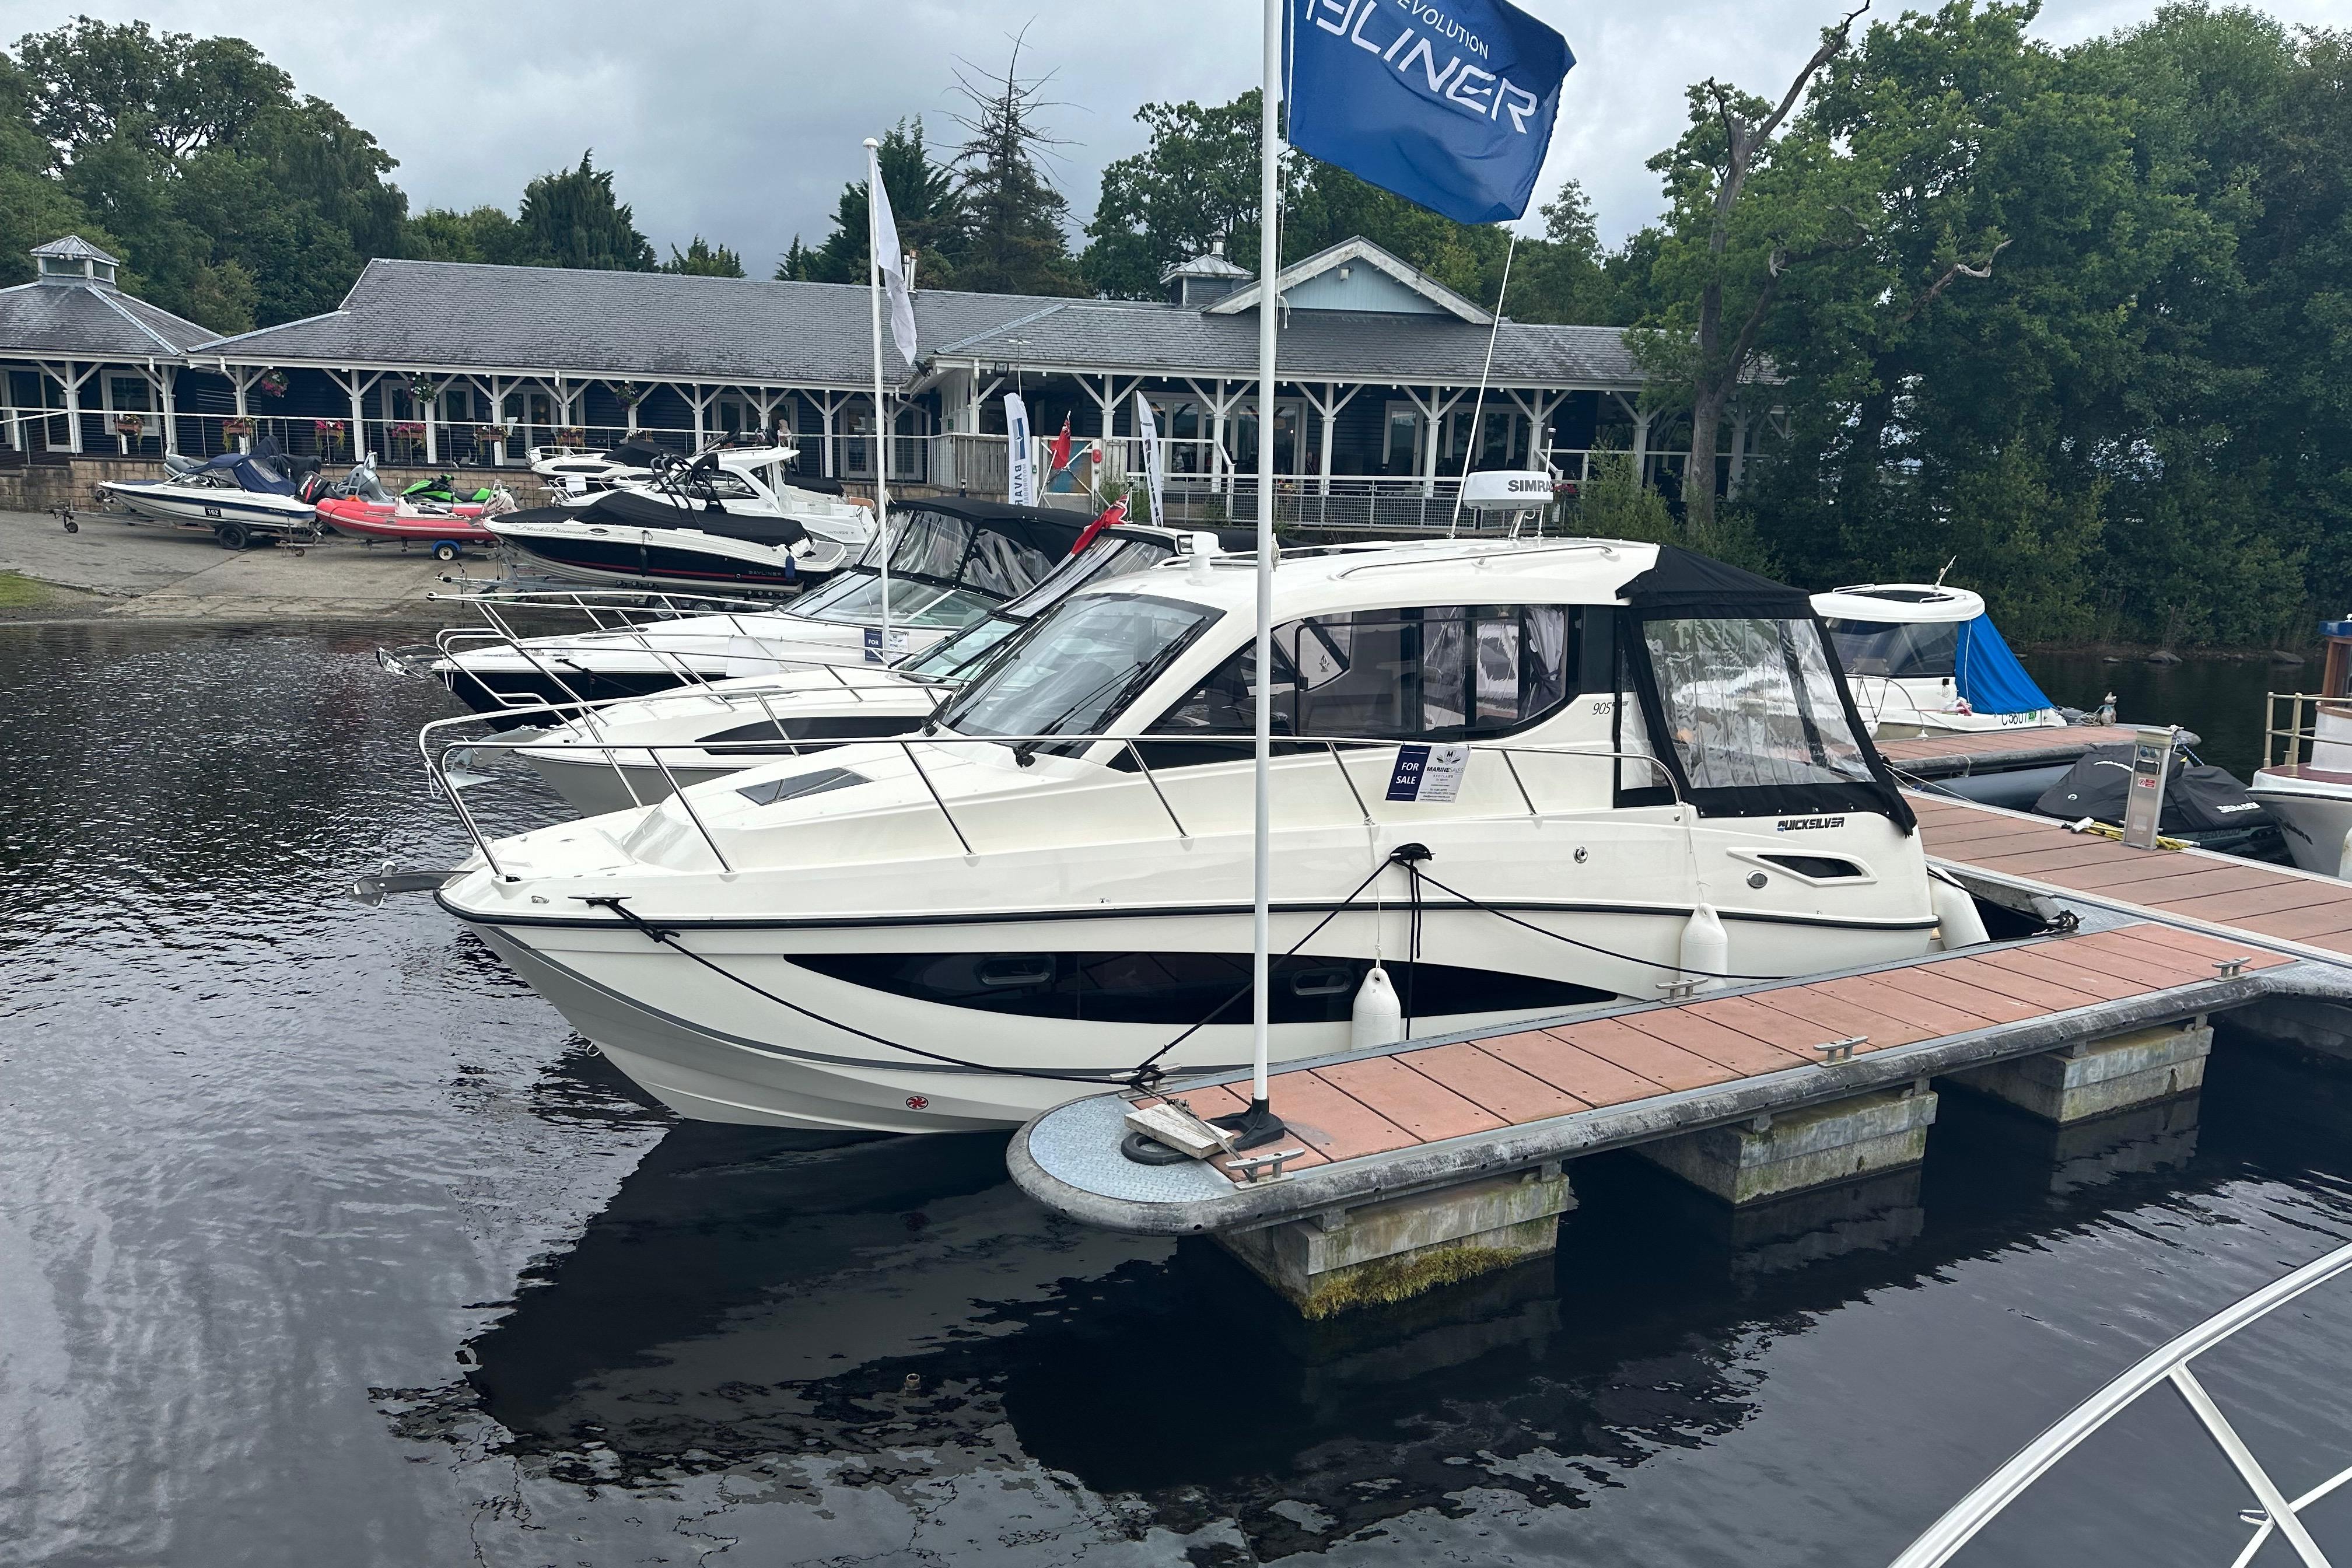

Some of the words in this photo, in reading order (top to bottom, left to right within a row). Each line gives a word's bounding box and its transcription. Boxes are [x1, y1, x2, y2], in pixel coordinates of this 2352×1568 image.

[1592, 702, 1612, 715] 905
[1401, 762, 1419, 771] FOR
[1395, 775, 1417, 785] SALE
[1777, 817, 1845, 832] QUICKSILVER
